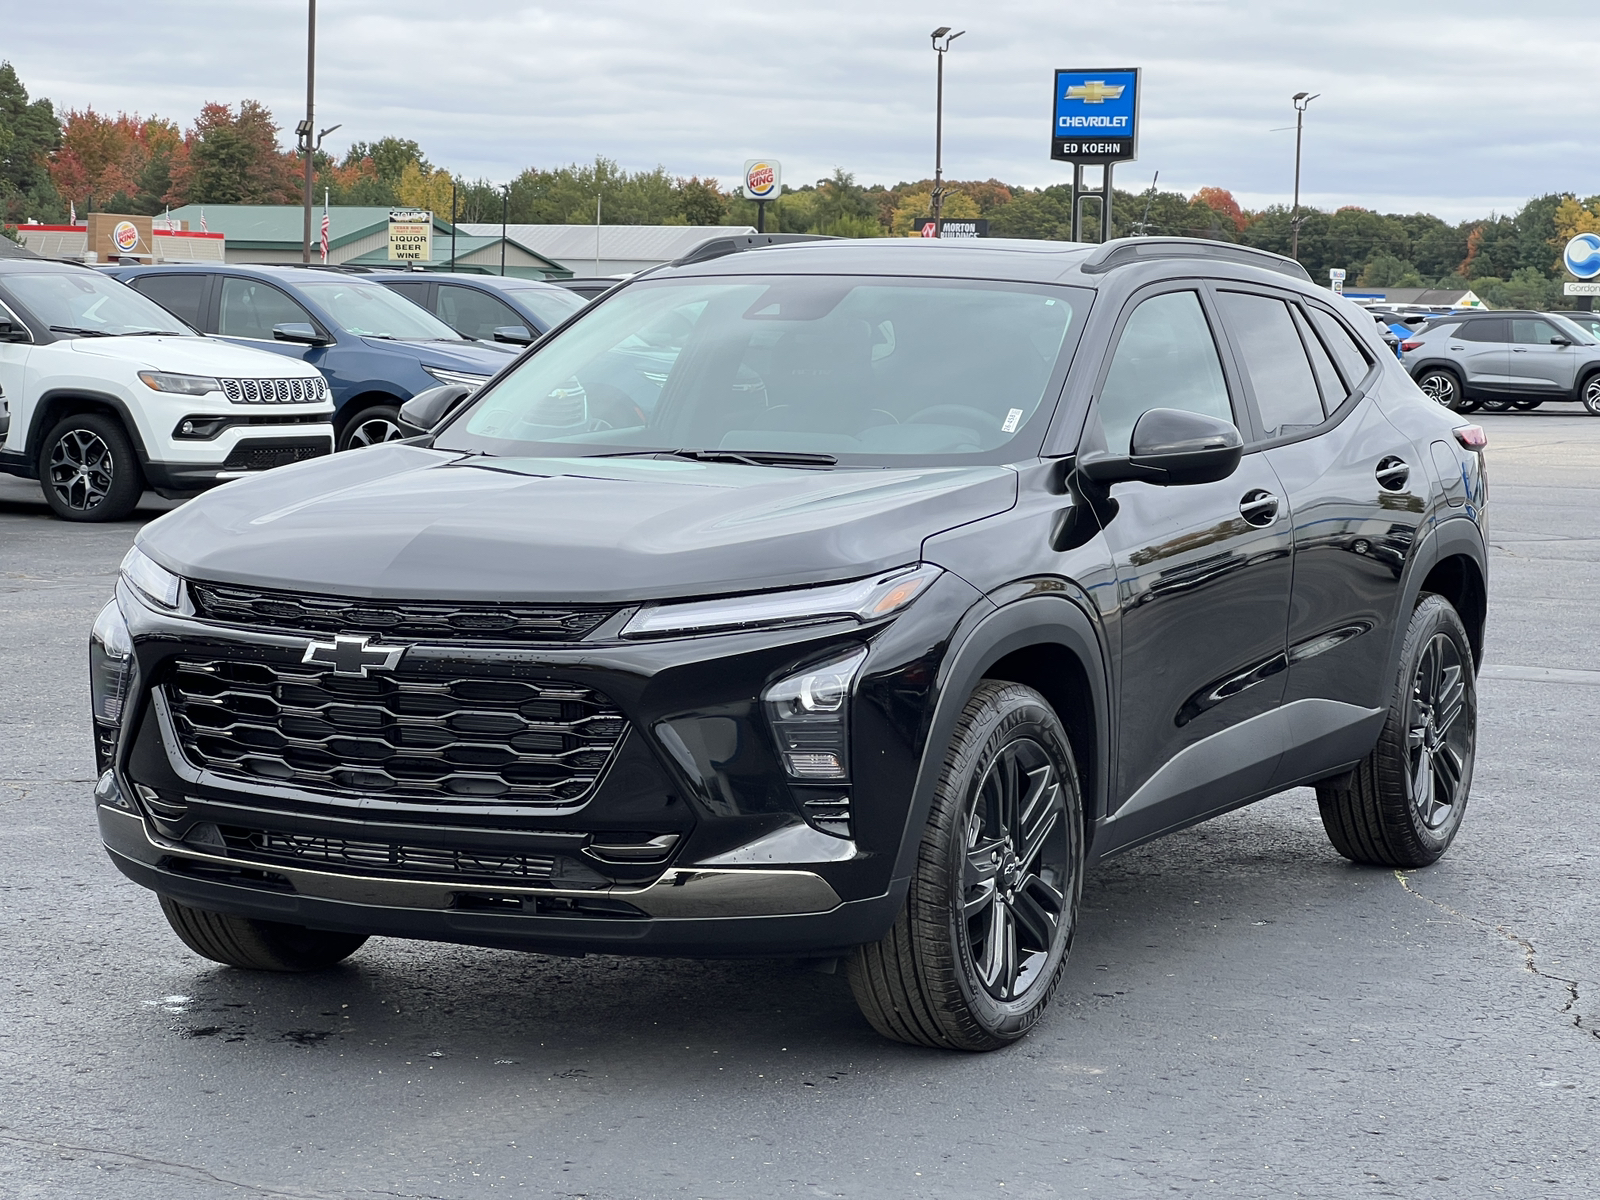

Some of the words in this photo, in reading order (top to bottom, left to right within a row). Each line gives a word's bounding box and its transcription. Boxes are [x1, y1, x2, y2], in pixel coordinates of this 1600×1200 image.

[1059, 116, 1128, 127] CHEVROLET
[1063, 143, 1078, 153] ED
[1082, 143, 1120, 153] KOEHN
[749, 168, 772, 180] BURGER
[750, 174, 773, 188] KING
[118, 227, 135, 238] BURGER
[943, 222, 976, 232] MORTON
[118, 232, 136, 244] KING
